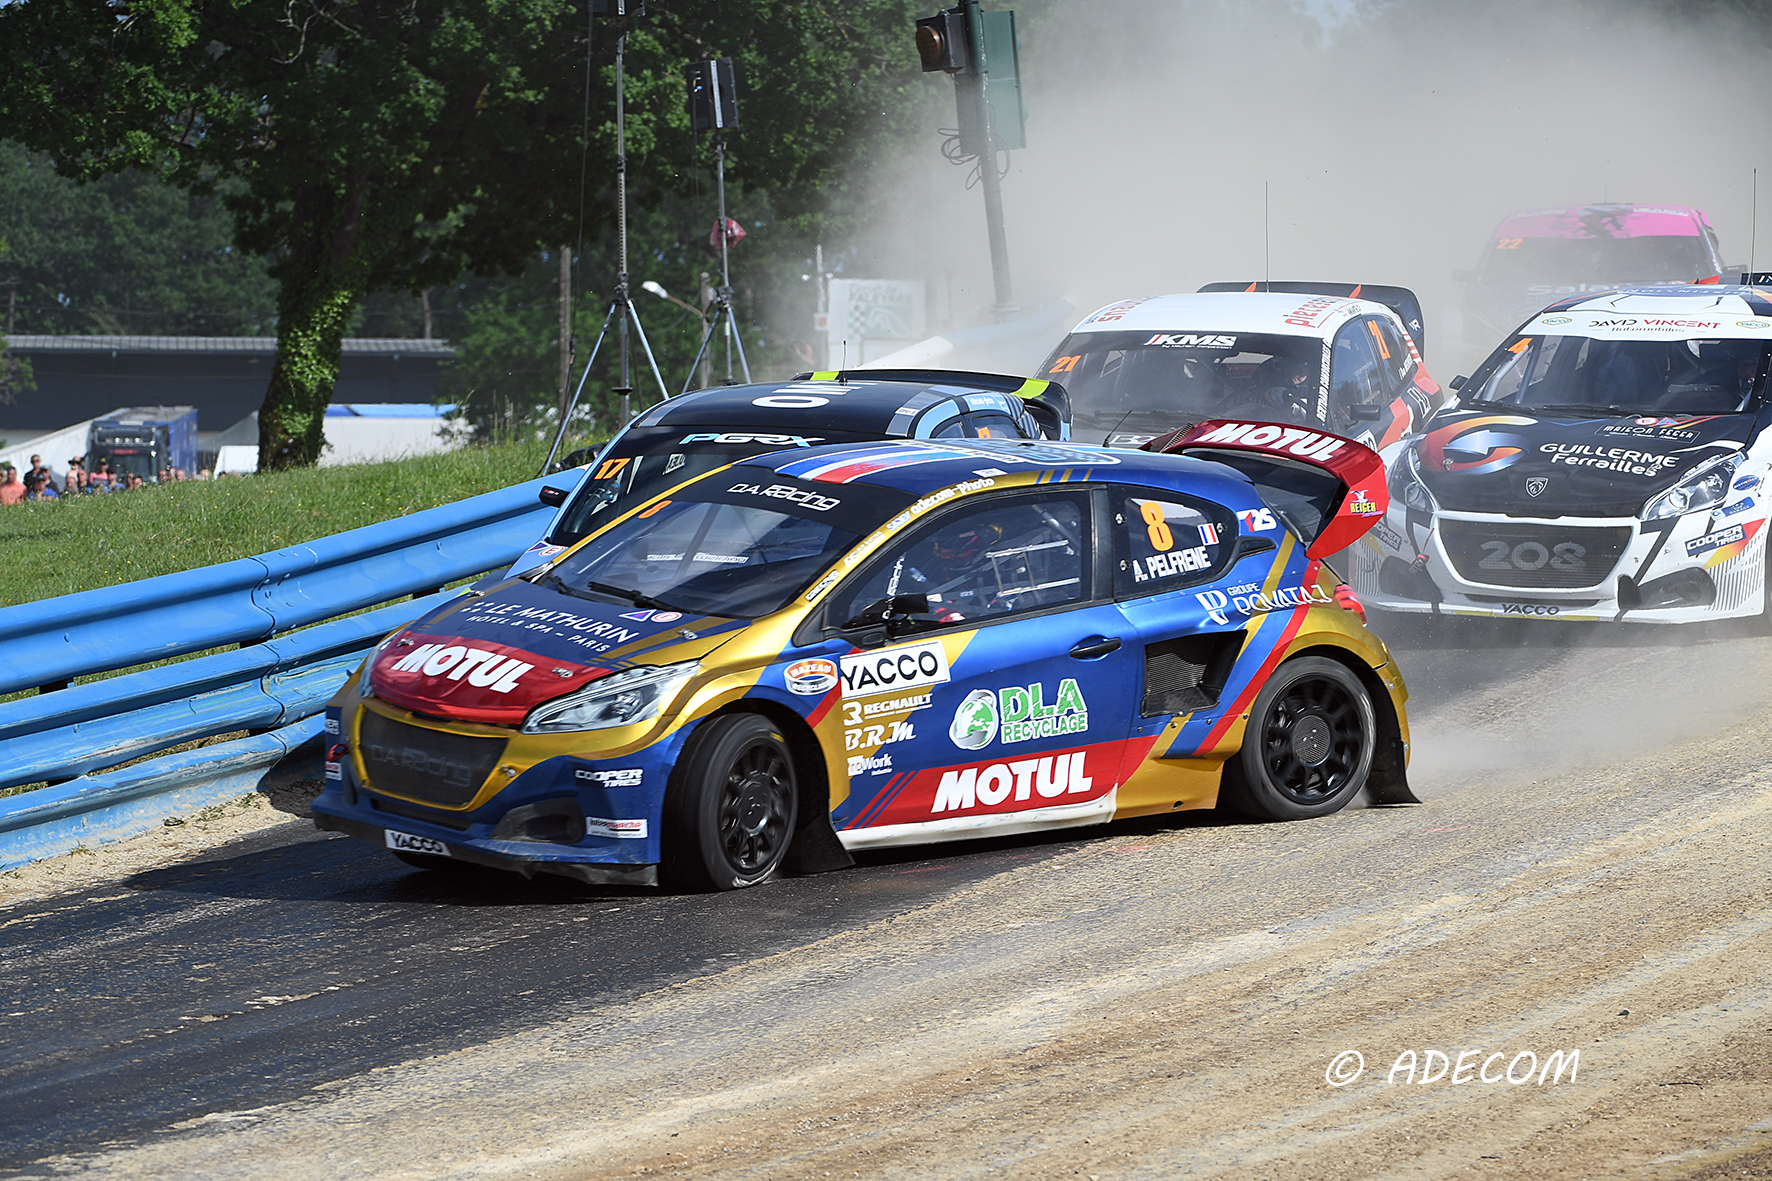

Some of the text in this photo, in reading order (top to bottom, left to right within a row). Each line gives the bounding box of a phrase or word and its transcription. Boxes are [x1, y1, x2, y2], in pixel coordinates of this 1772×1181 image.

[1496, 238, 1522, 250] 22
[1588, 319, 1721, 329] DAVID VINCENT
[1367, 320, 1391, 360] 21
[1508, 338, 1533, 353] 4
[1049, 355, 1081, 374] 21
[679, 432, 825, 447] PGRX
[1199, 423, 1347, 461] MOTUL
[1540, 443, 1680, 467] GUILLERME
[1551, 453, 1662, 477] Ferrailles
[594, 458, 631, 480] 17
[638, 500, 673, 519] 8
[1140, 501, 1174, 551] 8
[1687, 525, 1743, 551] COOPER
[1715, 532, 1744, 547] TIRES
[1133, 546, 1212, 582] A. PELFRENE
[1478, 541, 1586, 572] 208
[1227, 583, 1260, 596] GROUPE
[1501, 603, 1560, 615] YACCO
[485, 604, 639, 643] LE MATHURIN
[524, 622, 554, 634] SPA
[567, 634, 611, 652] PARIS
[391, 643, 535, 694] MOTUL
[841, 651, 938, 691] YACCO
[863, 693, 933, 716] REGNAULT
[999, 679, 1087, 724] DLA
[1001, 712, 1088, 744] RECYCLAGE
[575, 768, 643, 781] COOPER
[602, 779, 642, 788] TIRES
[931, 751, 1093, 813] MOTUL
[390, 832, 445, 852] YACCO
